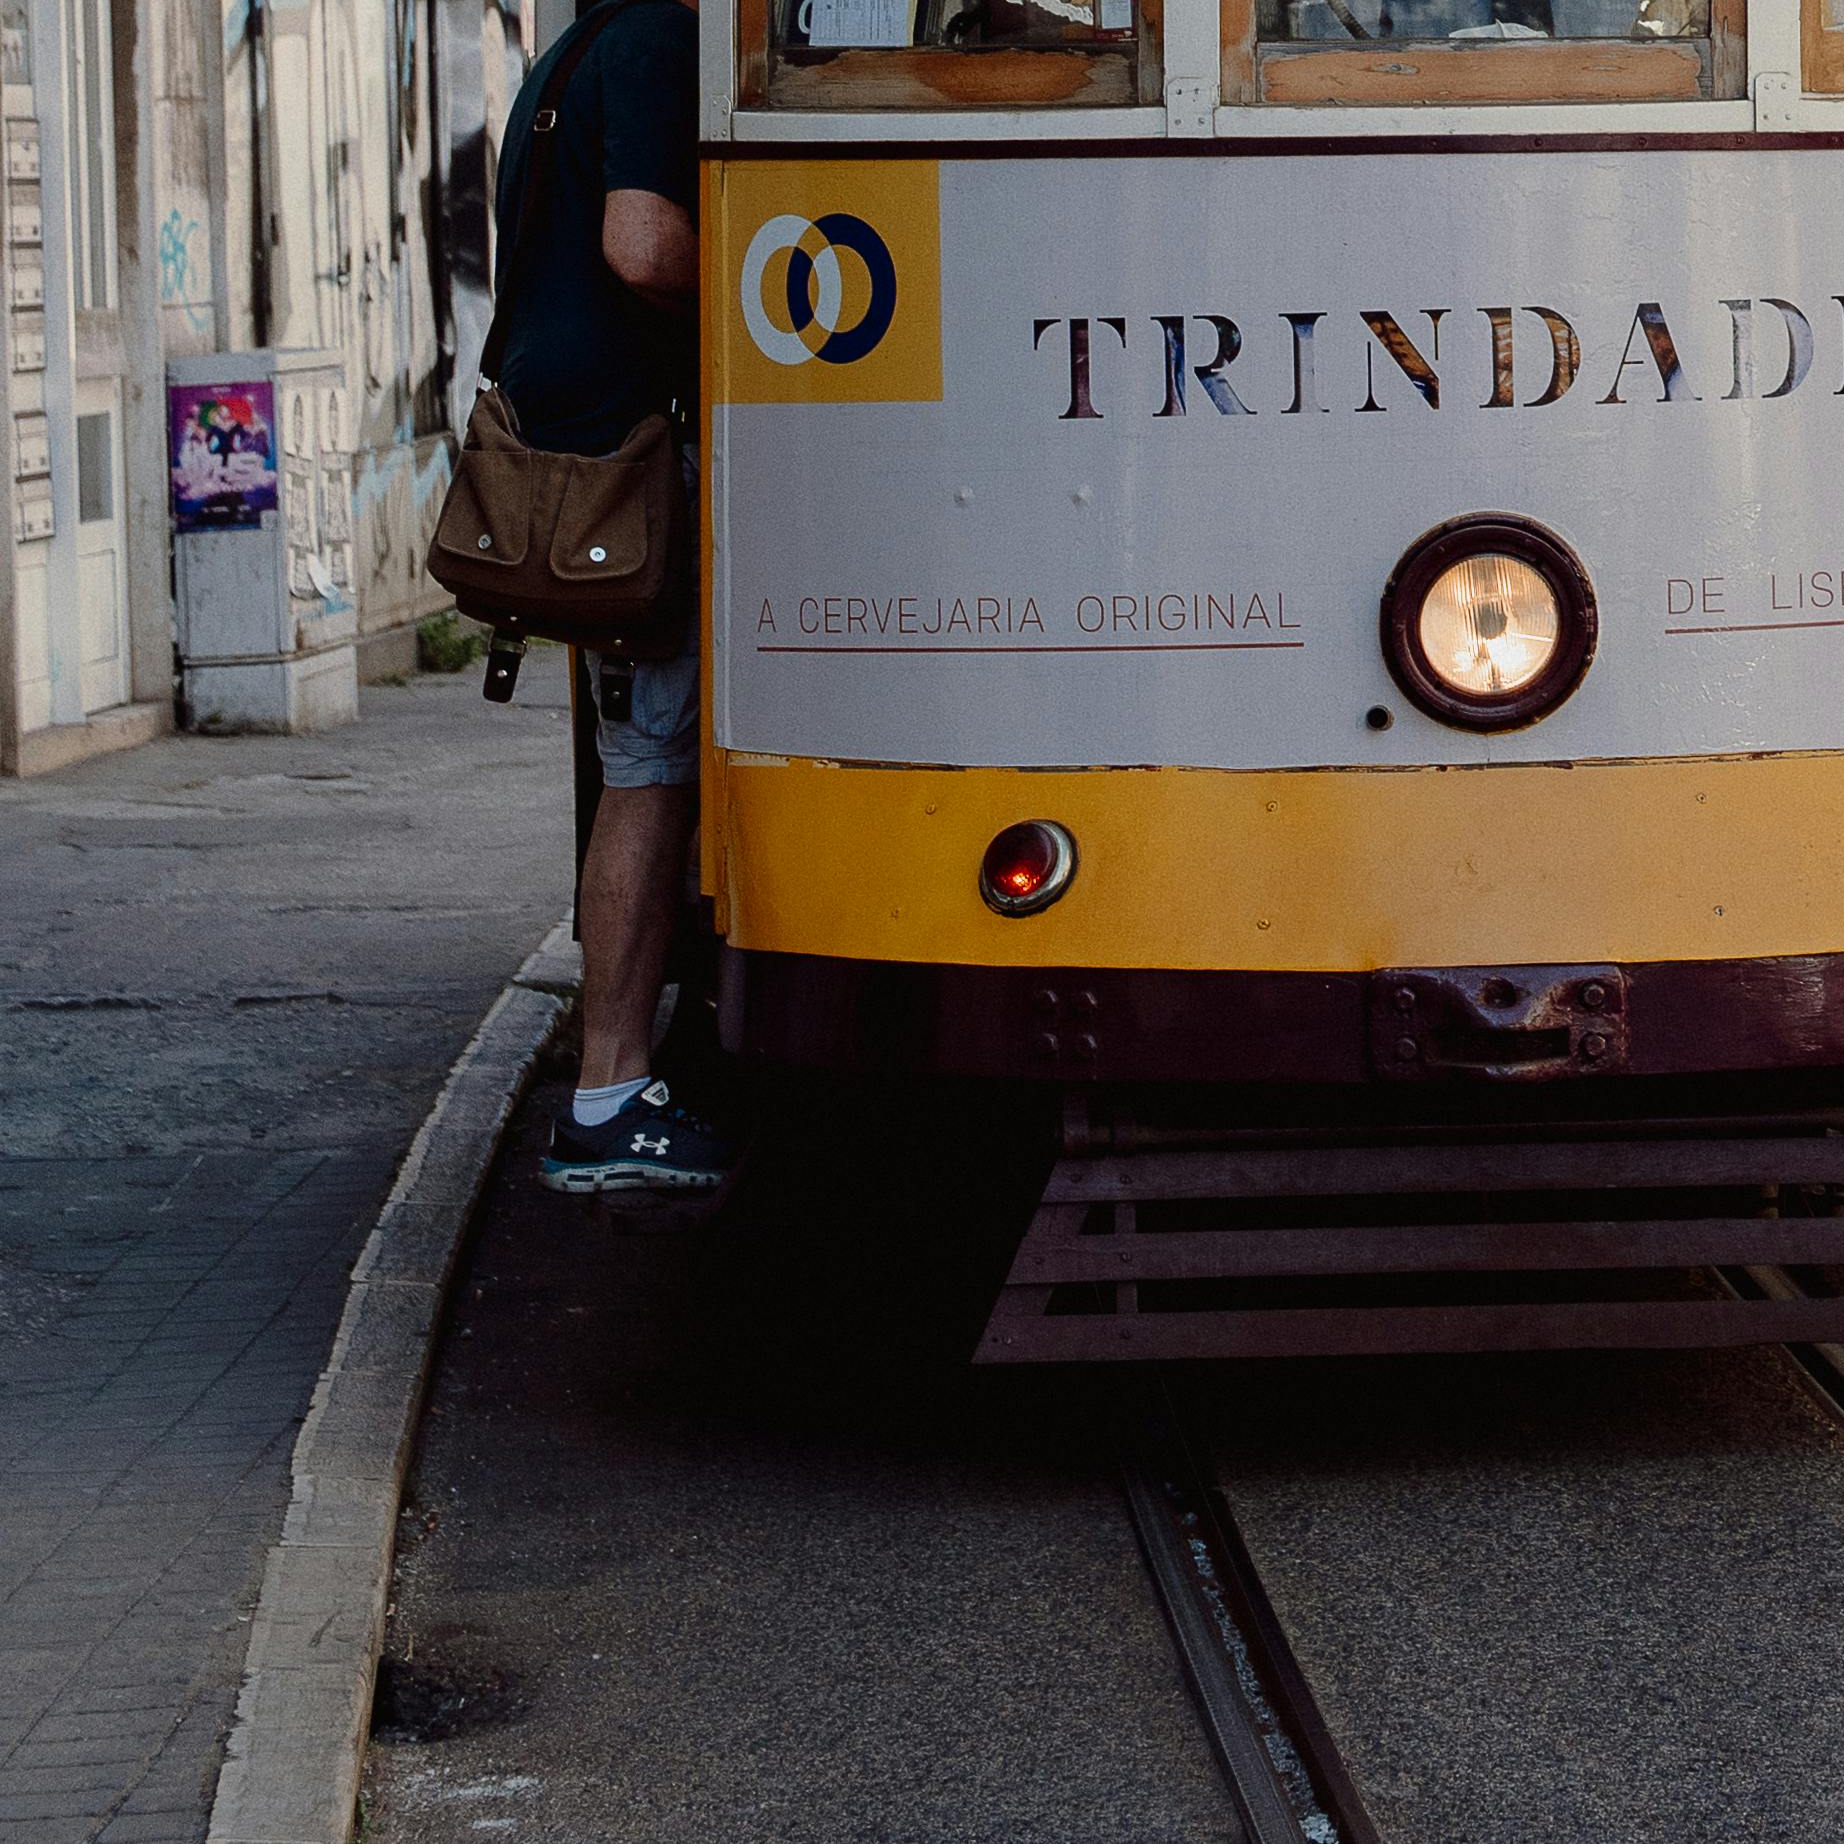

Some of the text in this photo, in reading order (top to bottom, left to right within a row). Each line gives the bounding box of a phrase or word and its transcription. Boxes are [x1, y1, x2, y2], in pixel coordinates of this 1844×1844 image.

[756, 591, 1303, 634] A CERVEJARIA ORIGINAL
[1666, 576, 1727, 616] DE
